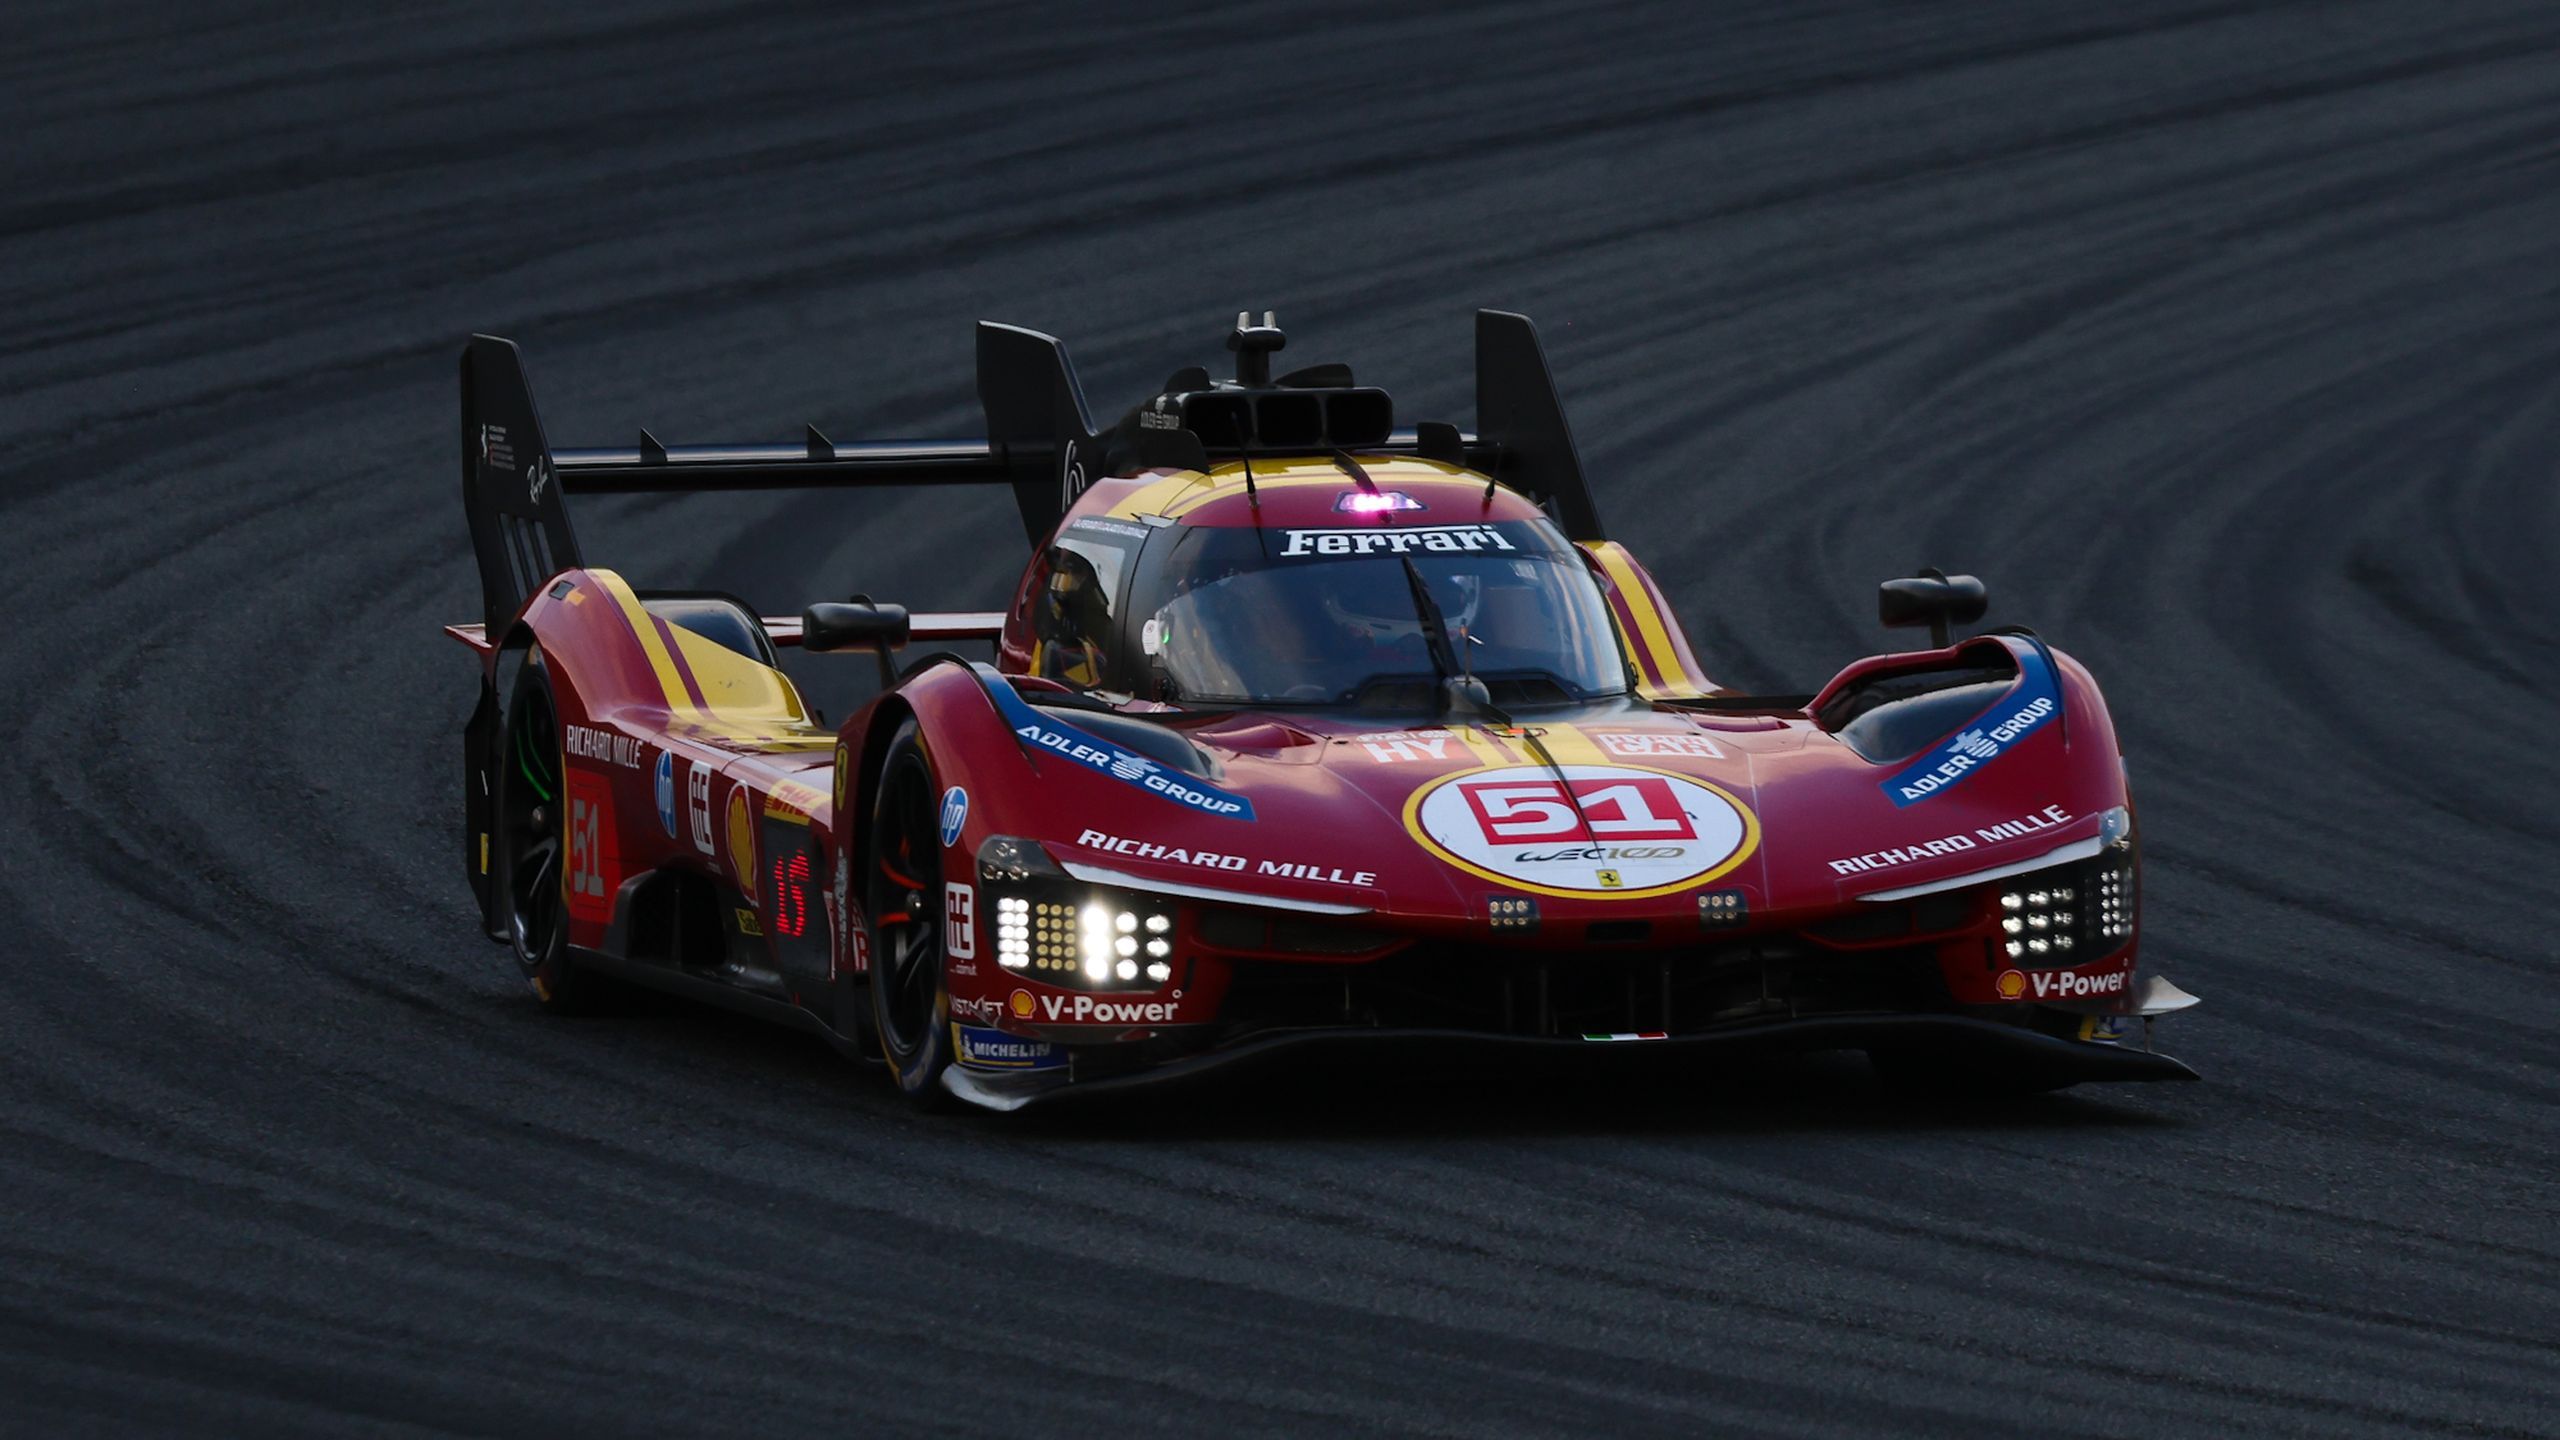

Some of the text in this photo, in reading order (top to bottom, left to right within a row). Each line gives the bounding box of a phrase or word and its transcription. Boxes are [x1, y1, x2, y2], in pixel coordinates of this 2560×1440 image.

[1279, 525, 1516, 557] Ferrari
[566, 724, 641, 769] RICHARD MILLE
[1017, 725, 1243, 817] ADLER GROUP
[1361, 738, 1448, 763] HY
[1900, 696, 2054, 800] ADLER GROUP
[943, 788, 967, 845] hp
[1475, 784, 1683, 836] 51
[571, 798, 605, 898] 51
[1077, 828, 1378, 887] RICHARD MILLE
[1828, 803, 2073, 876] RICHARD MILLE
[1040, 995, 1179, 1022] V-Power
[2030, 970, 2126, 998] V-Power
[973, 1042, 1051, 1058] MICHELIN
